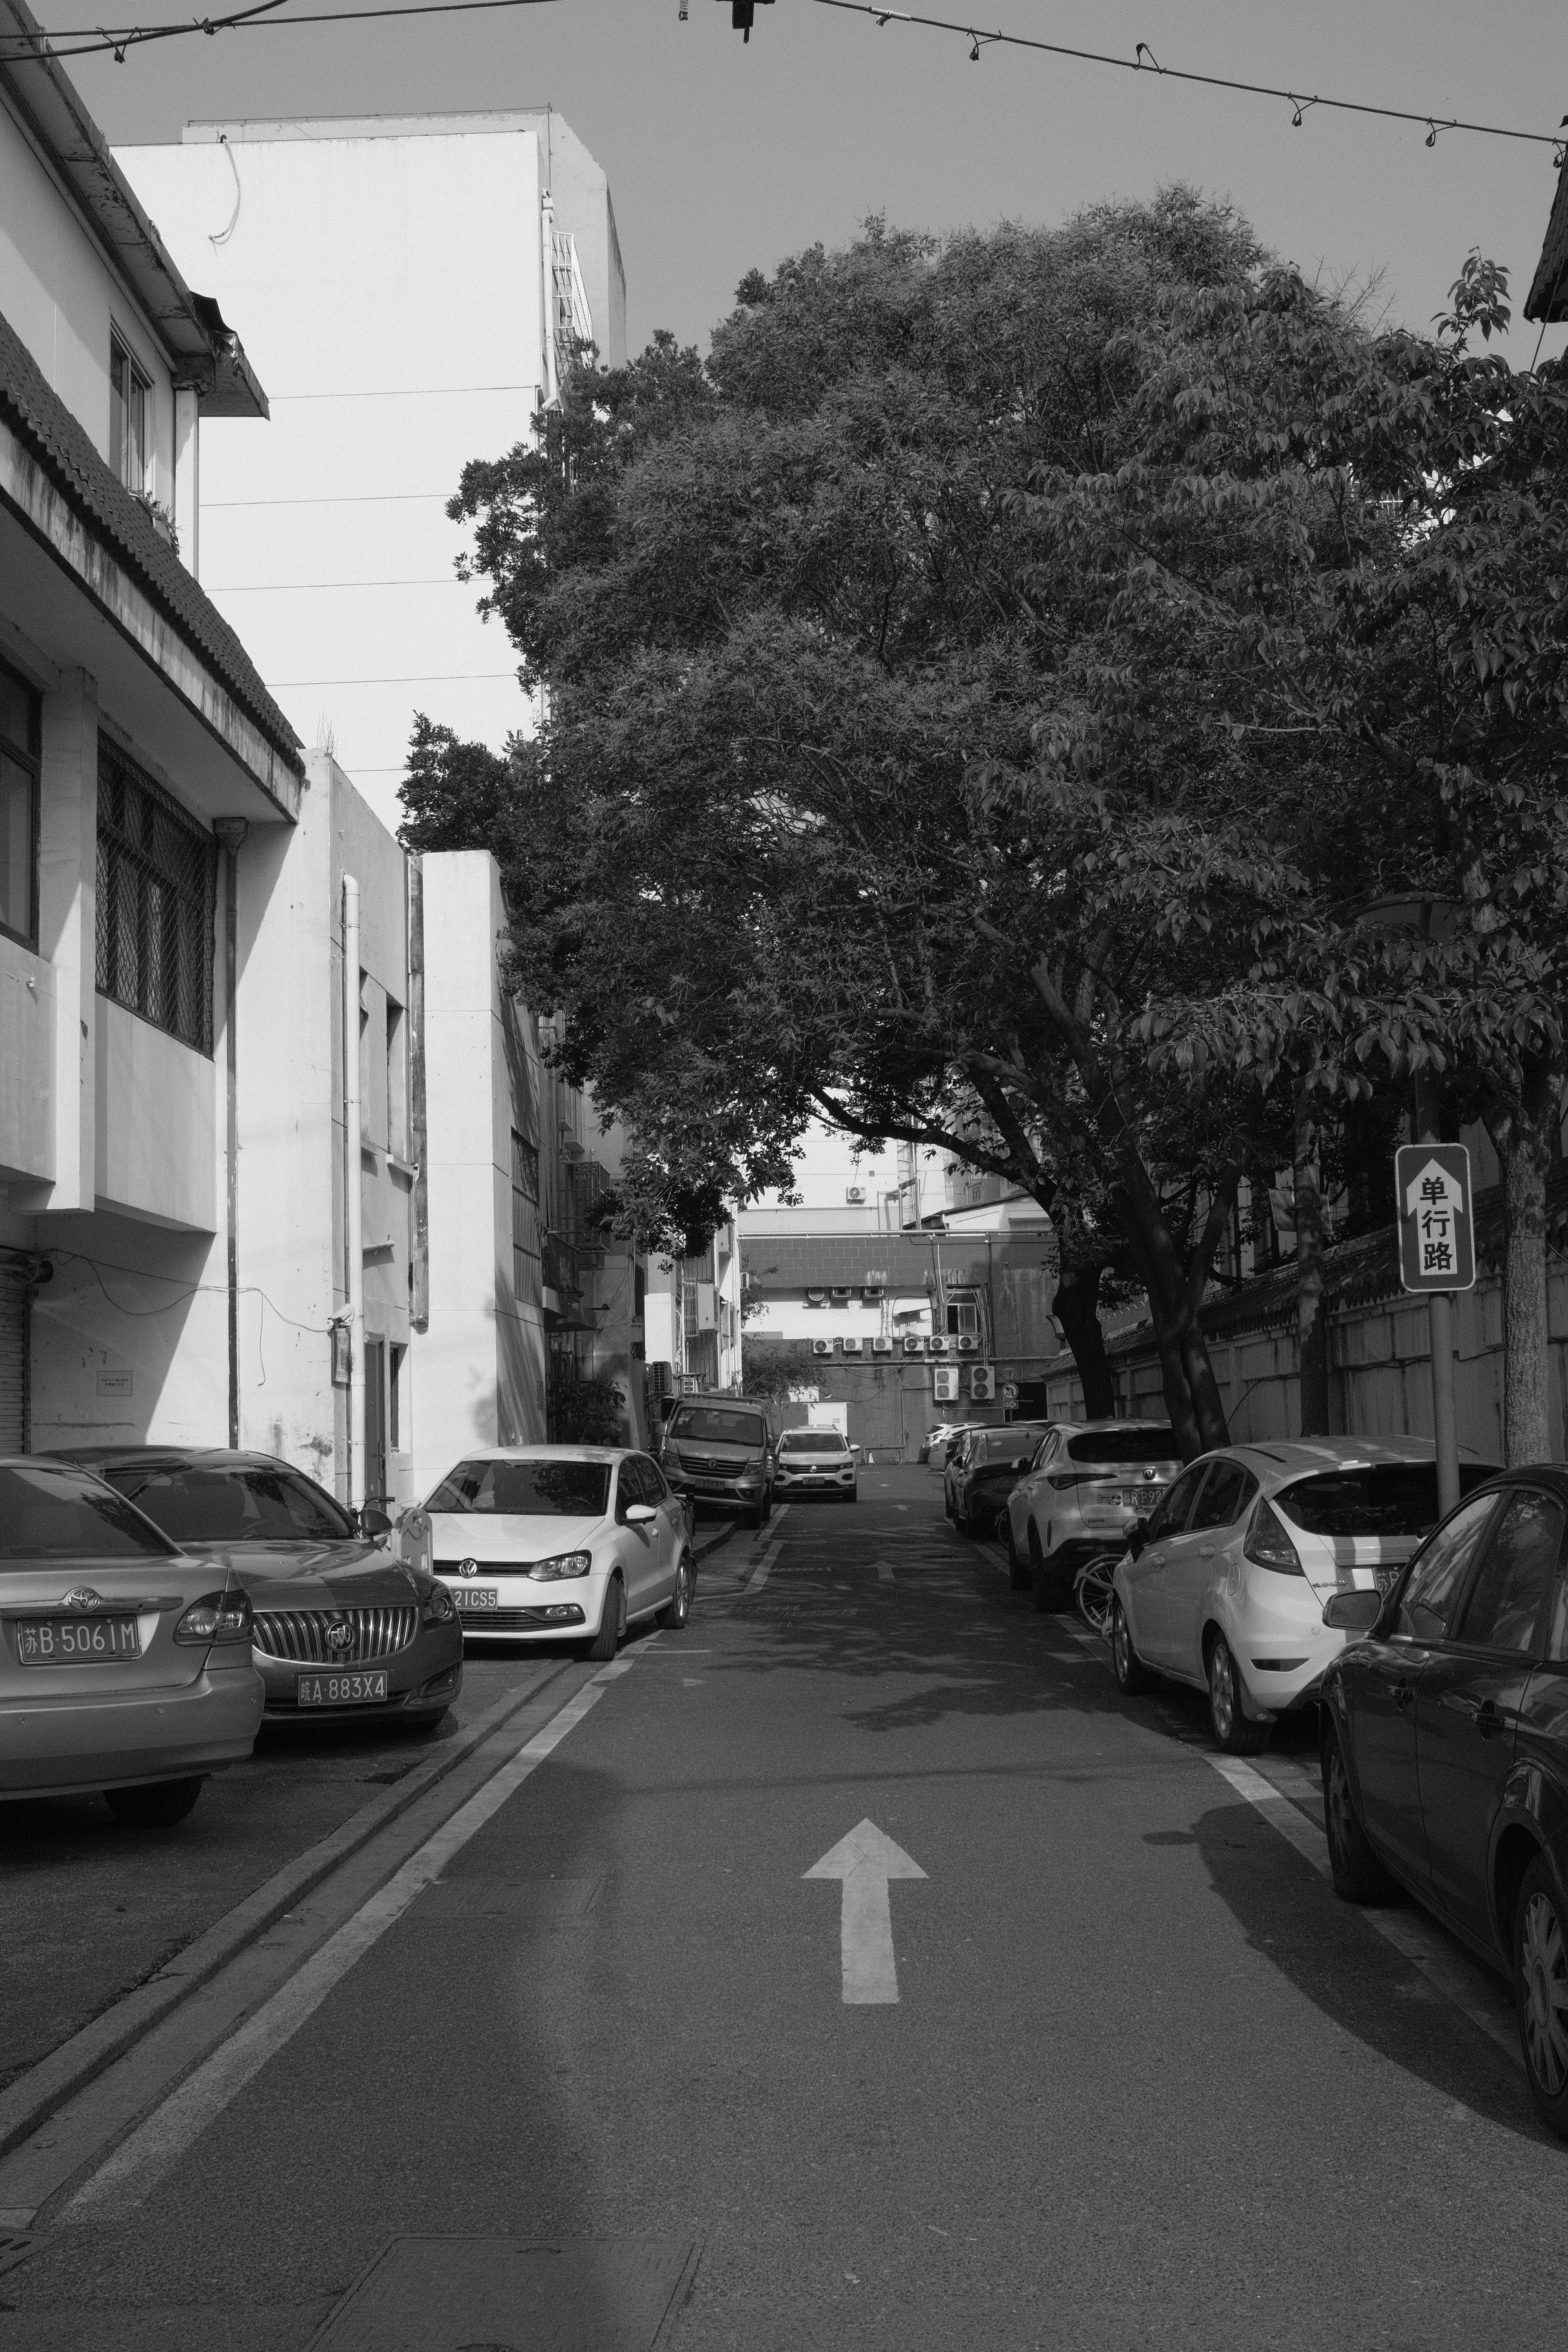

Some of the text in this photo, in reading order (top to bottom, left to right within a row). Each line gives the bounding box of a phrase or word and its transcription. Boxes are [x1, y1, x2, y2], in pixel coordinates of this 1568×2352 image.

[1419, 1176, 1453, 1270] 单行路
[25, 1623, 136, 1654] 苏B·5061M
[301, 1676, 385, 1701] 皖A·883X4
